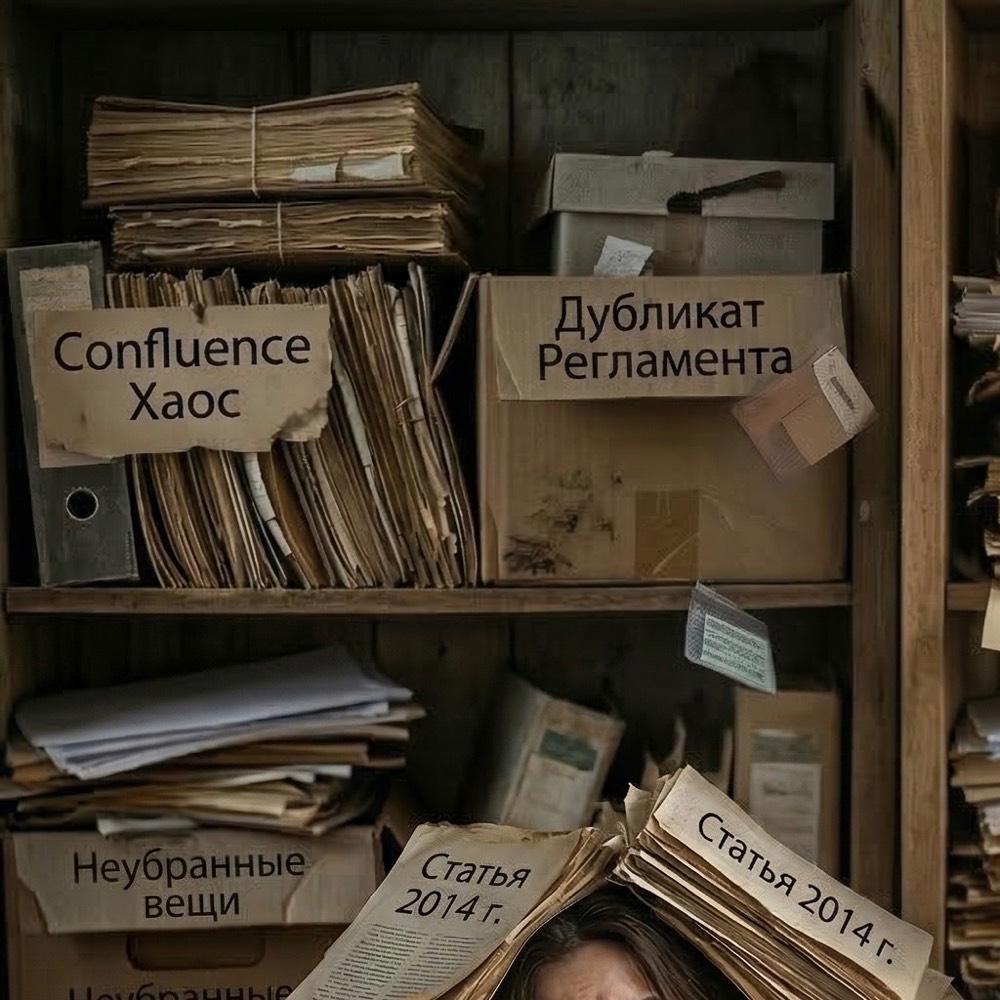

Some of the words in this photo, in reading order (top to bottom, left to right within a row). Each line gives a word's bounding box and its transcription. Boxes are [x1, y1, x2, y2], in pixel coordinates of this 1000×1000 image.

[555, 292, 765, 343] Дубликат
[54, 327, 311, 372] Confluence
[538, 343, 793, 381] Регламента
[129, 381, 241, 421] Хаос
[73, 848, 306, 890] Неубранные
[421, 853, 532, 889] Статья
[698, 812, 797, 897] Статья
[798, 884, 874, 947] 2014
[876, 938, 895, 965] г.
[145, 892, 240, 922] вещи
[395, 888, 480, 922] 2014
[481, 903, 504, 925] г.
